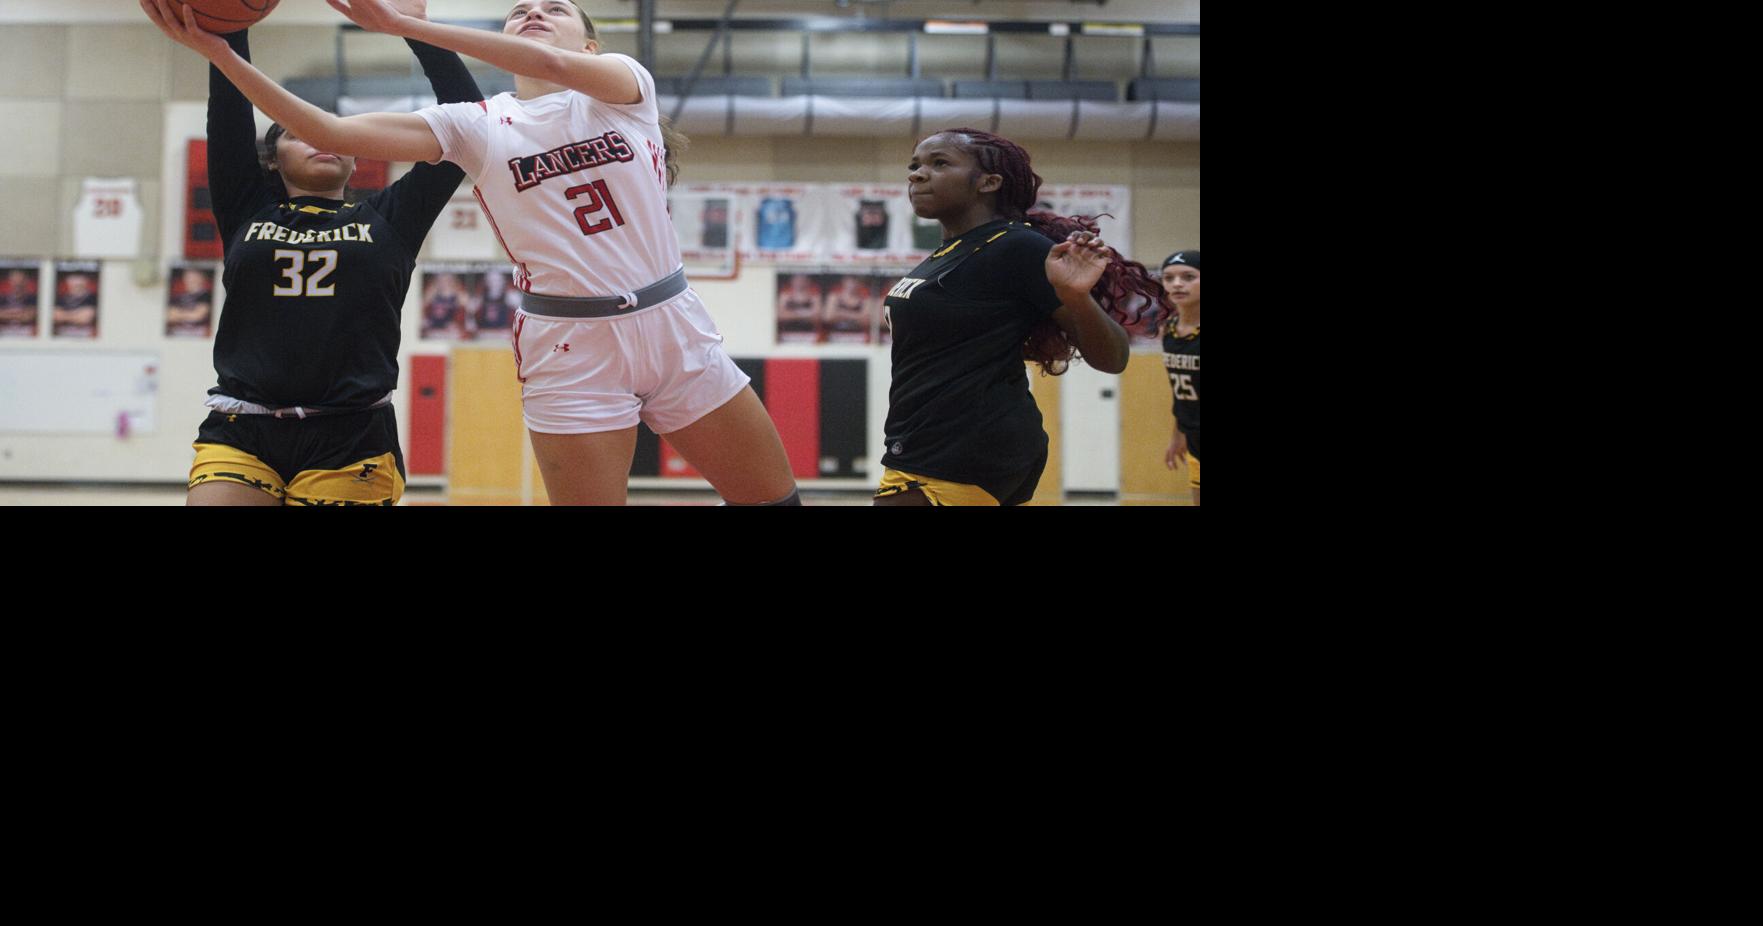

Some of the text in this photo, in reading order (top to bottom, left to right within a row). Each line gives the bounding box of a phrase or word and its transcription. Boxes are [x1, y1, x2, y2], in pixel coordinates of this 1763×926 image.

[508, 131, 634, 192] LANCERS
[564, 179, 625, 236] 21
[244, 221, 374, 245] FREDERICK
[273, 249, 338, 297] 32
[1169, 372, 1198, 401] 25
